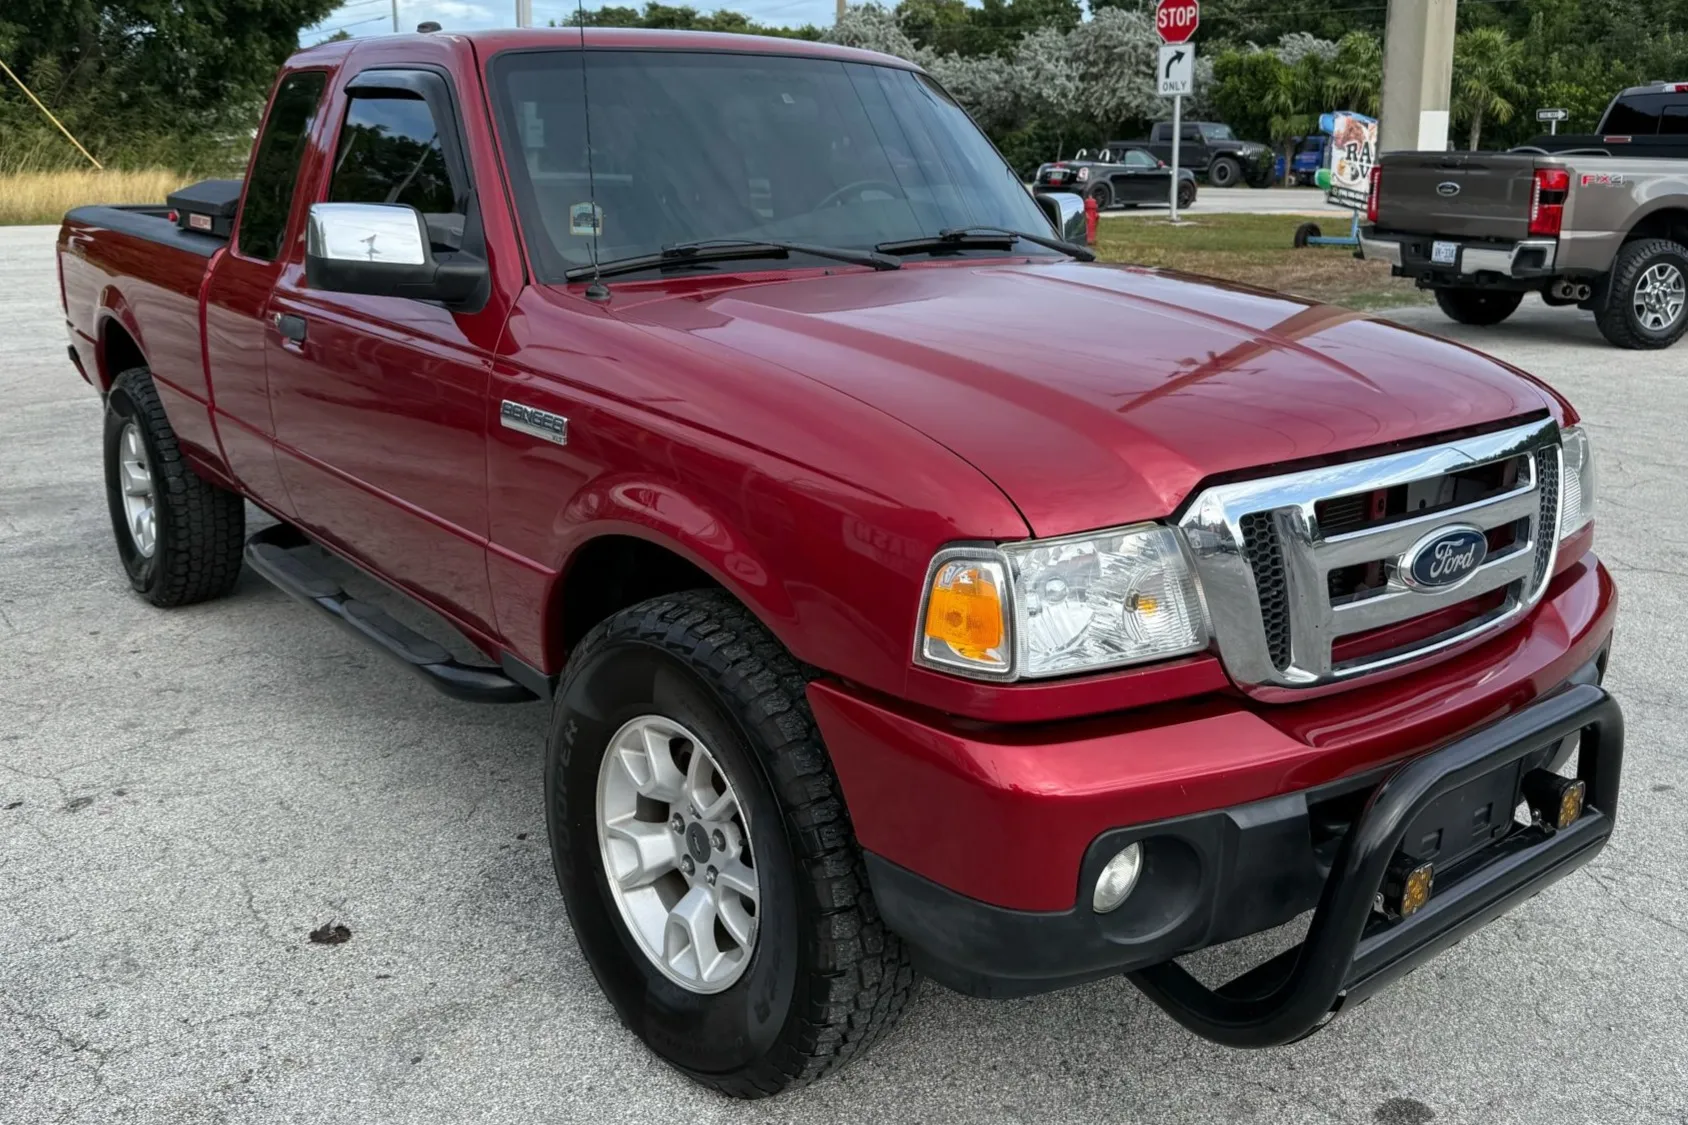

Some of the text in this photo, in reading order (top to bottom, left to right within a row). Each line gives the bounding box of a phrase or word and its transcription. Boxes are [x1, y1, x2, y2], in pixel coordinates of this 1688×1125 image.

[1158, 5, 1196, 28] STOP
[1162, 81, 1187, 92] ONLY
[1346, 141, 1376, 163] RA
[1581, 174, 1625, 187] FX4
[503, 402, 564, 433] RANGER
[1430, 538, 1476, 578] Ford
